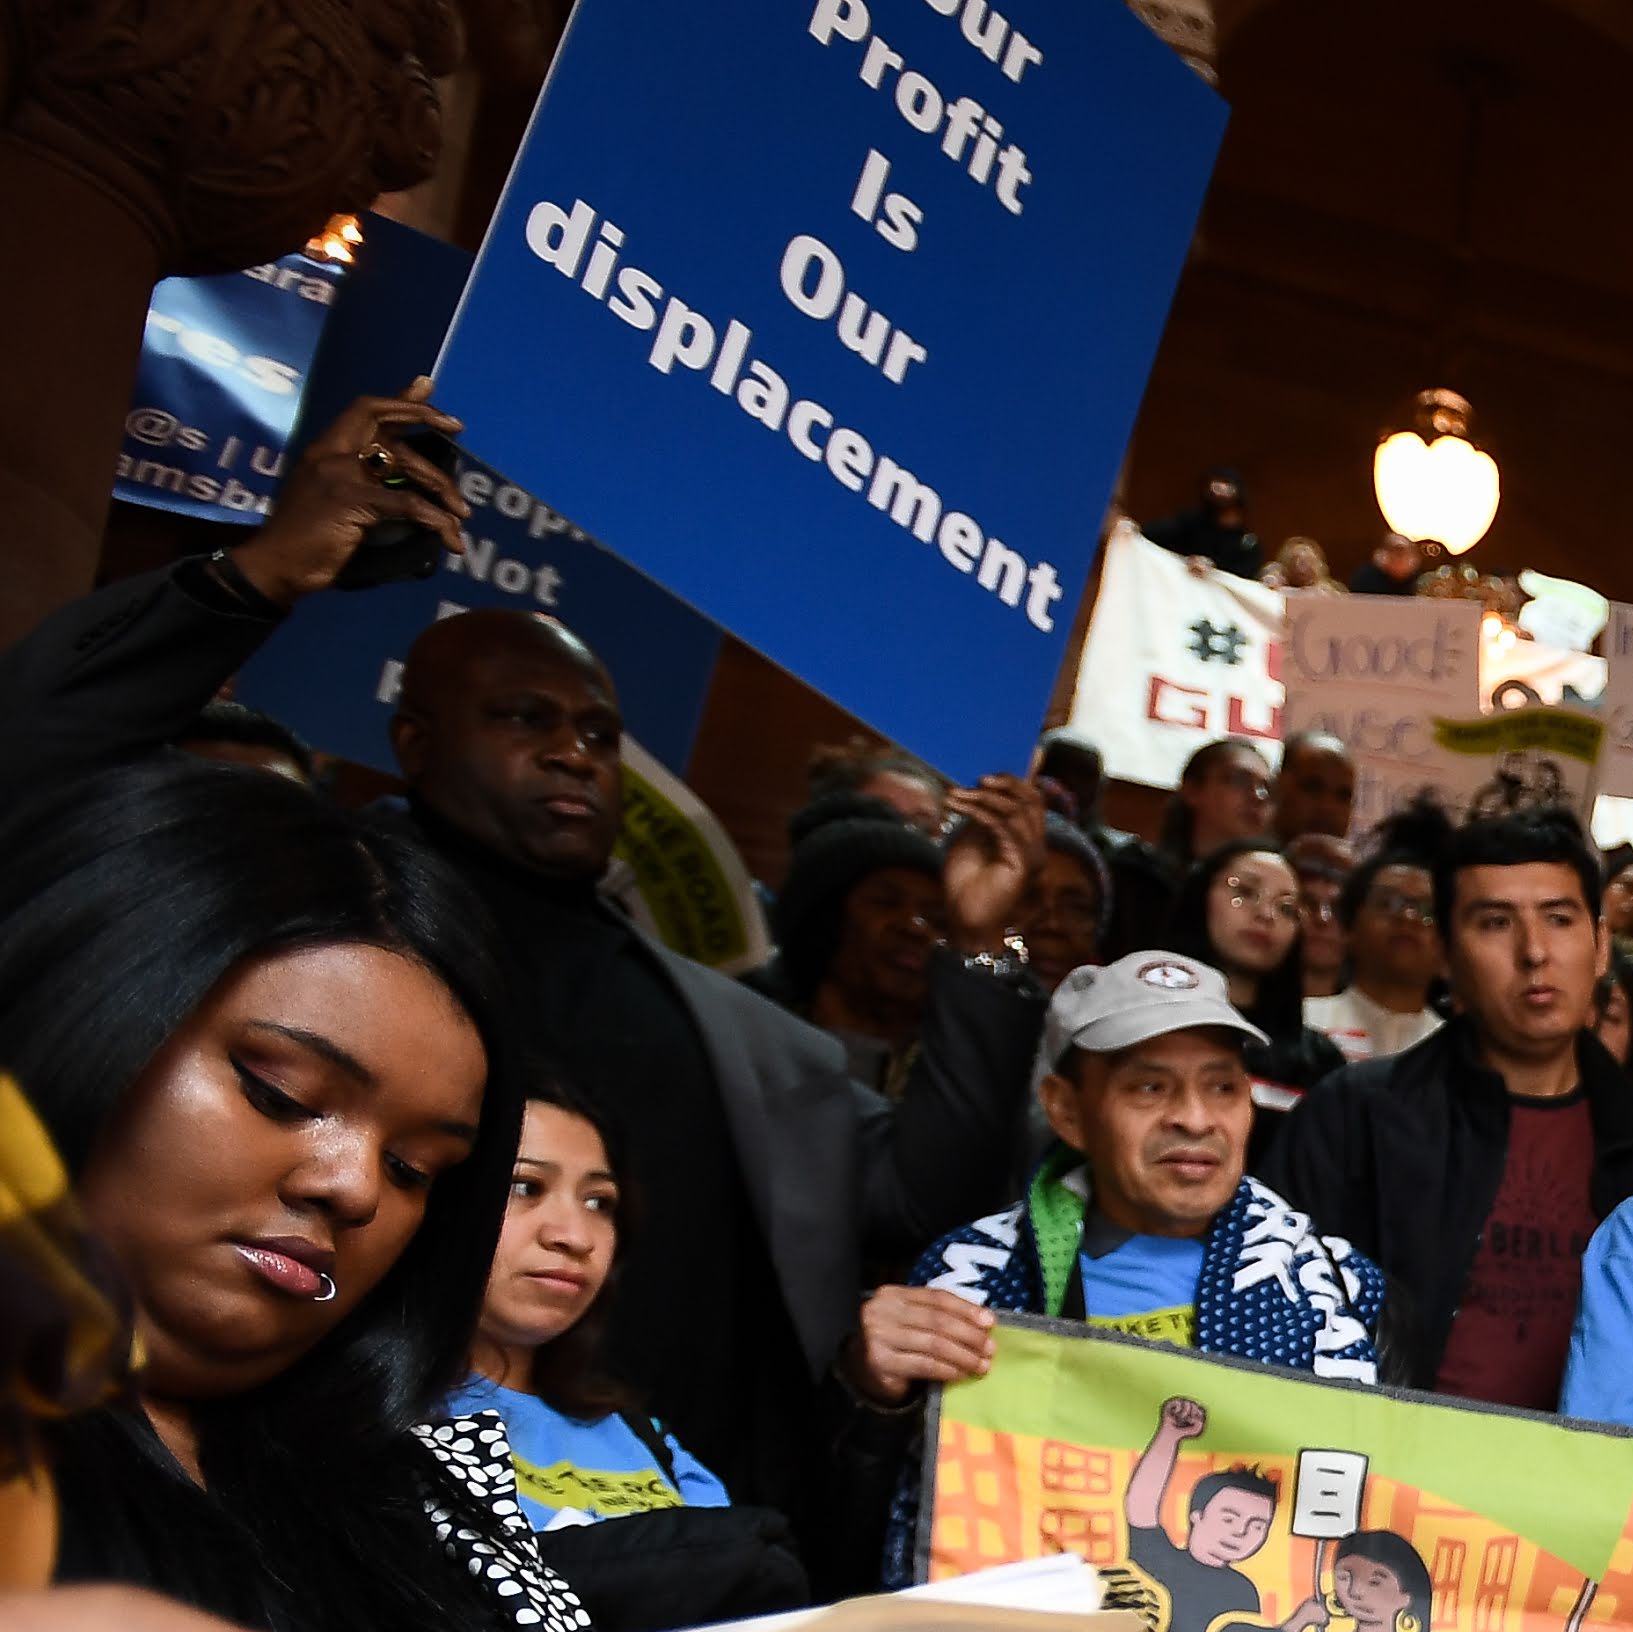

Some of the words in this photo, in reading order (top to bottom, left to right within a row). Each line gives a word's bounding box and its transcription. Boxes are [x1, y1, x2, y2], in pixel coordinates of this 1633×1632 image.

[921, 0, 1043, 83] ur
[851, 147, 924, 252] Is
[779, 234, 927, 384] Our
[525, 198, 1062, 633] displacement
[455, 460, 588, 541] eop
[445, 532, 565, 606] Not
